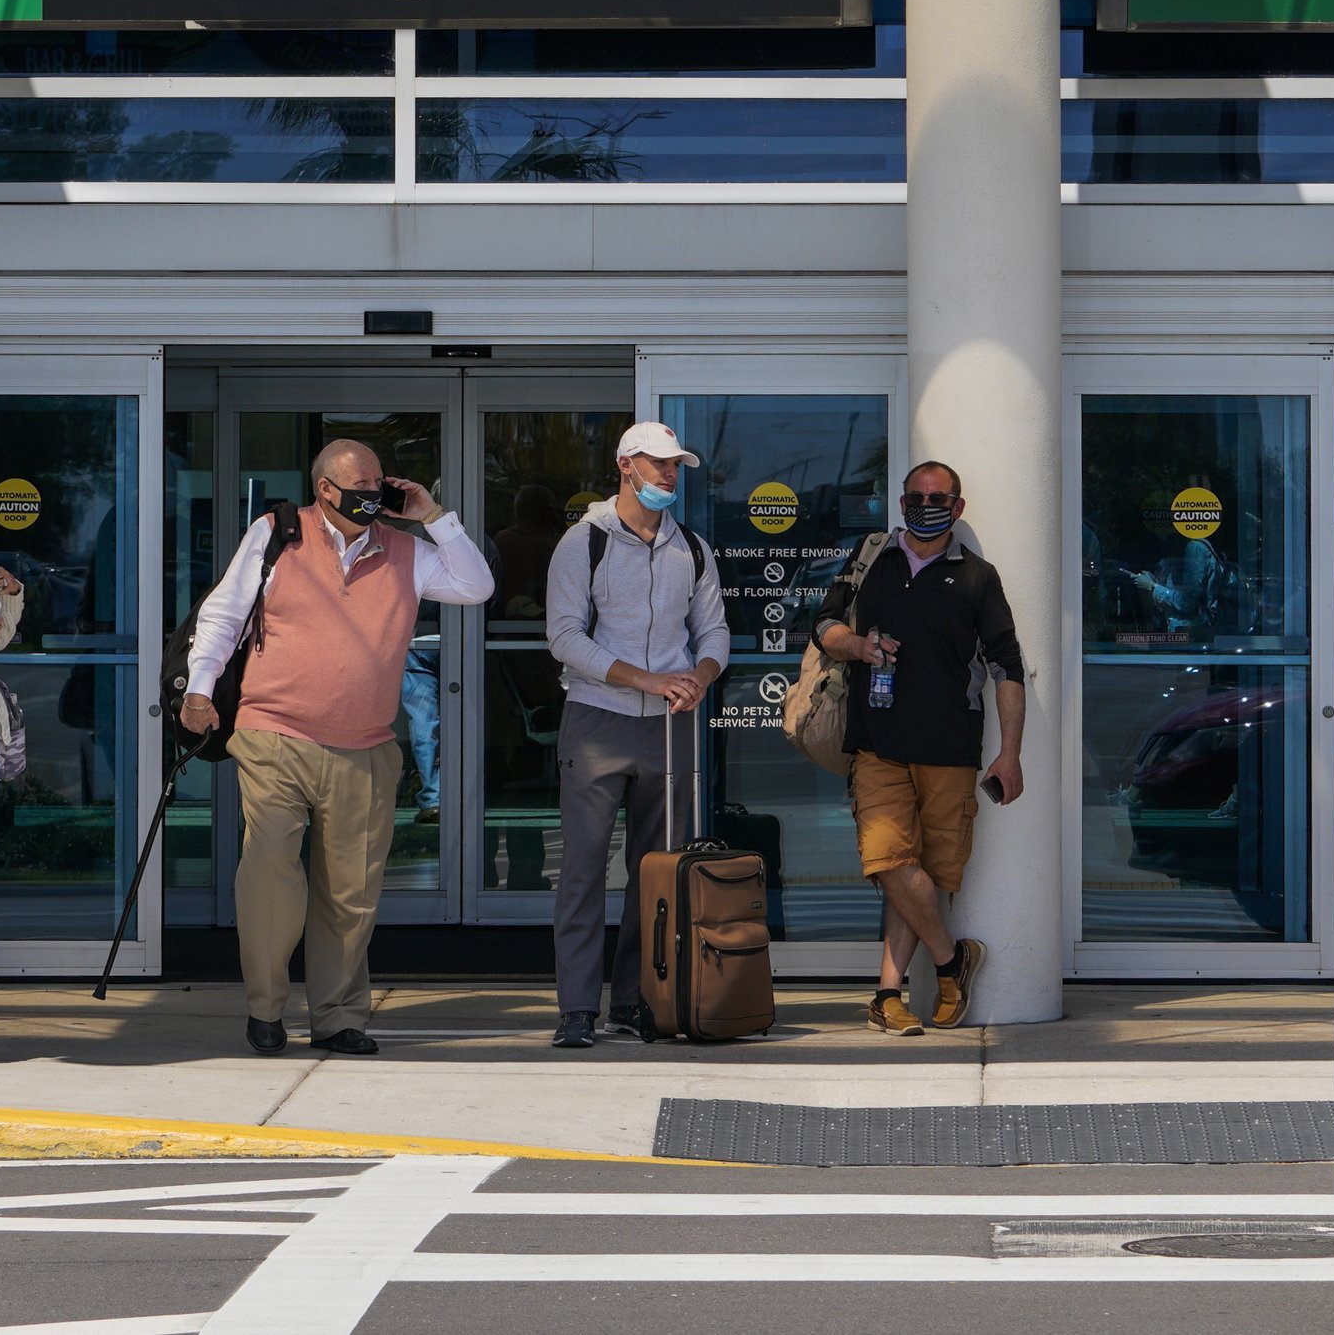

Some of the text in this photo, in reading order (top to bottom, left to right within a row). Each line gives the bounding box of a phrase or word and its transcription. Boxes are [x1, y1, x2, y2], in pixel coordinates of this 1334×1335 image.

[750, 507, 796, 515] CAUTION
[1173, 512, 1220, 521] CAUTION
[725, 548, 765, 558] SMOKE
[769, 548, 797, 558] FREE
[801, 548, 854, 558] ENVIRON
[744, 587, 791, 597] FLORIDA
[795, 587, 829, 597] STATU
[1117, 635, 1145, 643] CAUTION
[722, 706, 739, 716] NO
[743, 706, 771, 716] PETS
[709, 718, 756, 728] SERVICE
